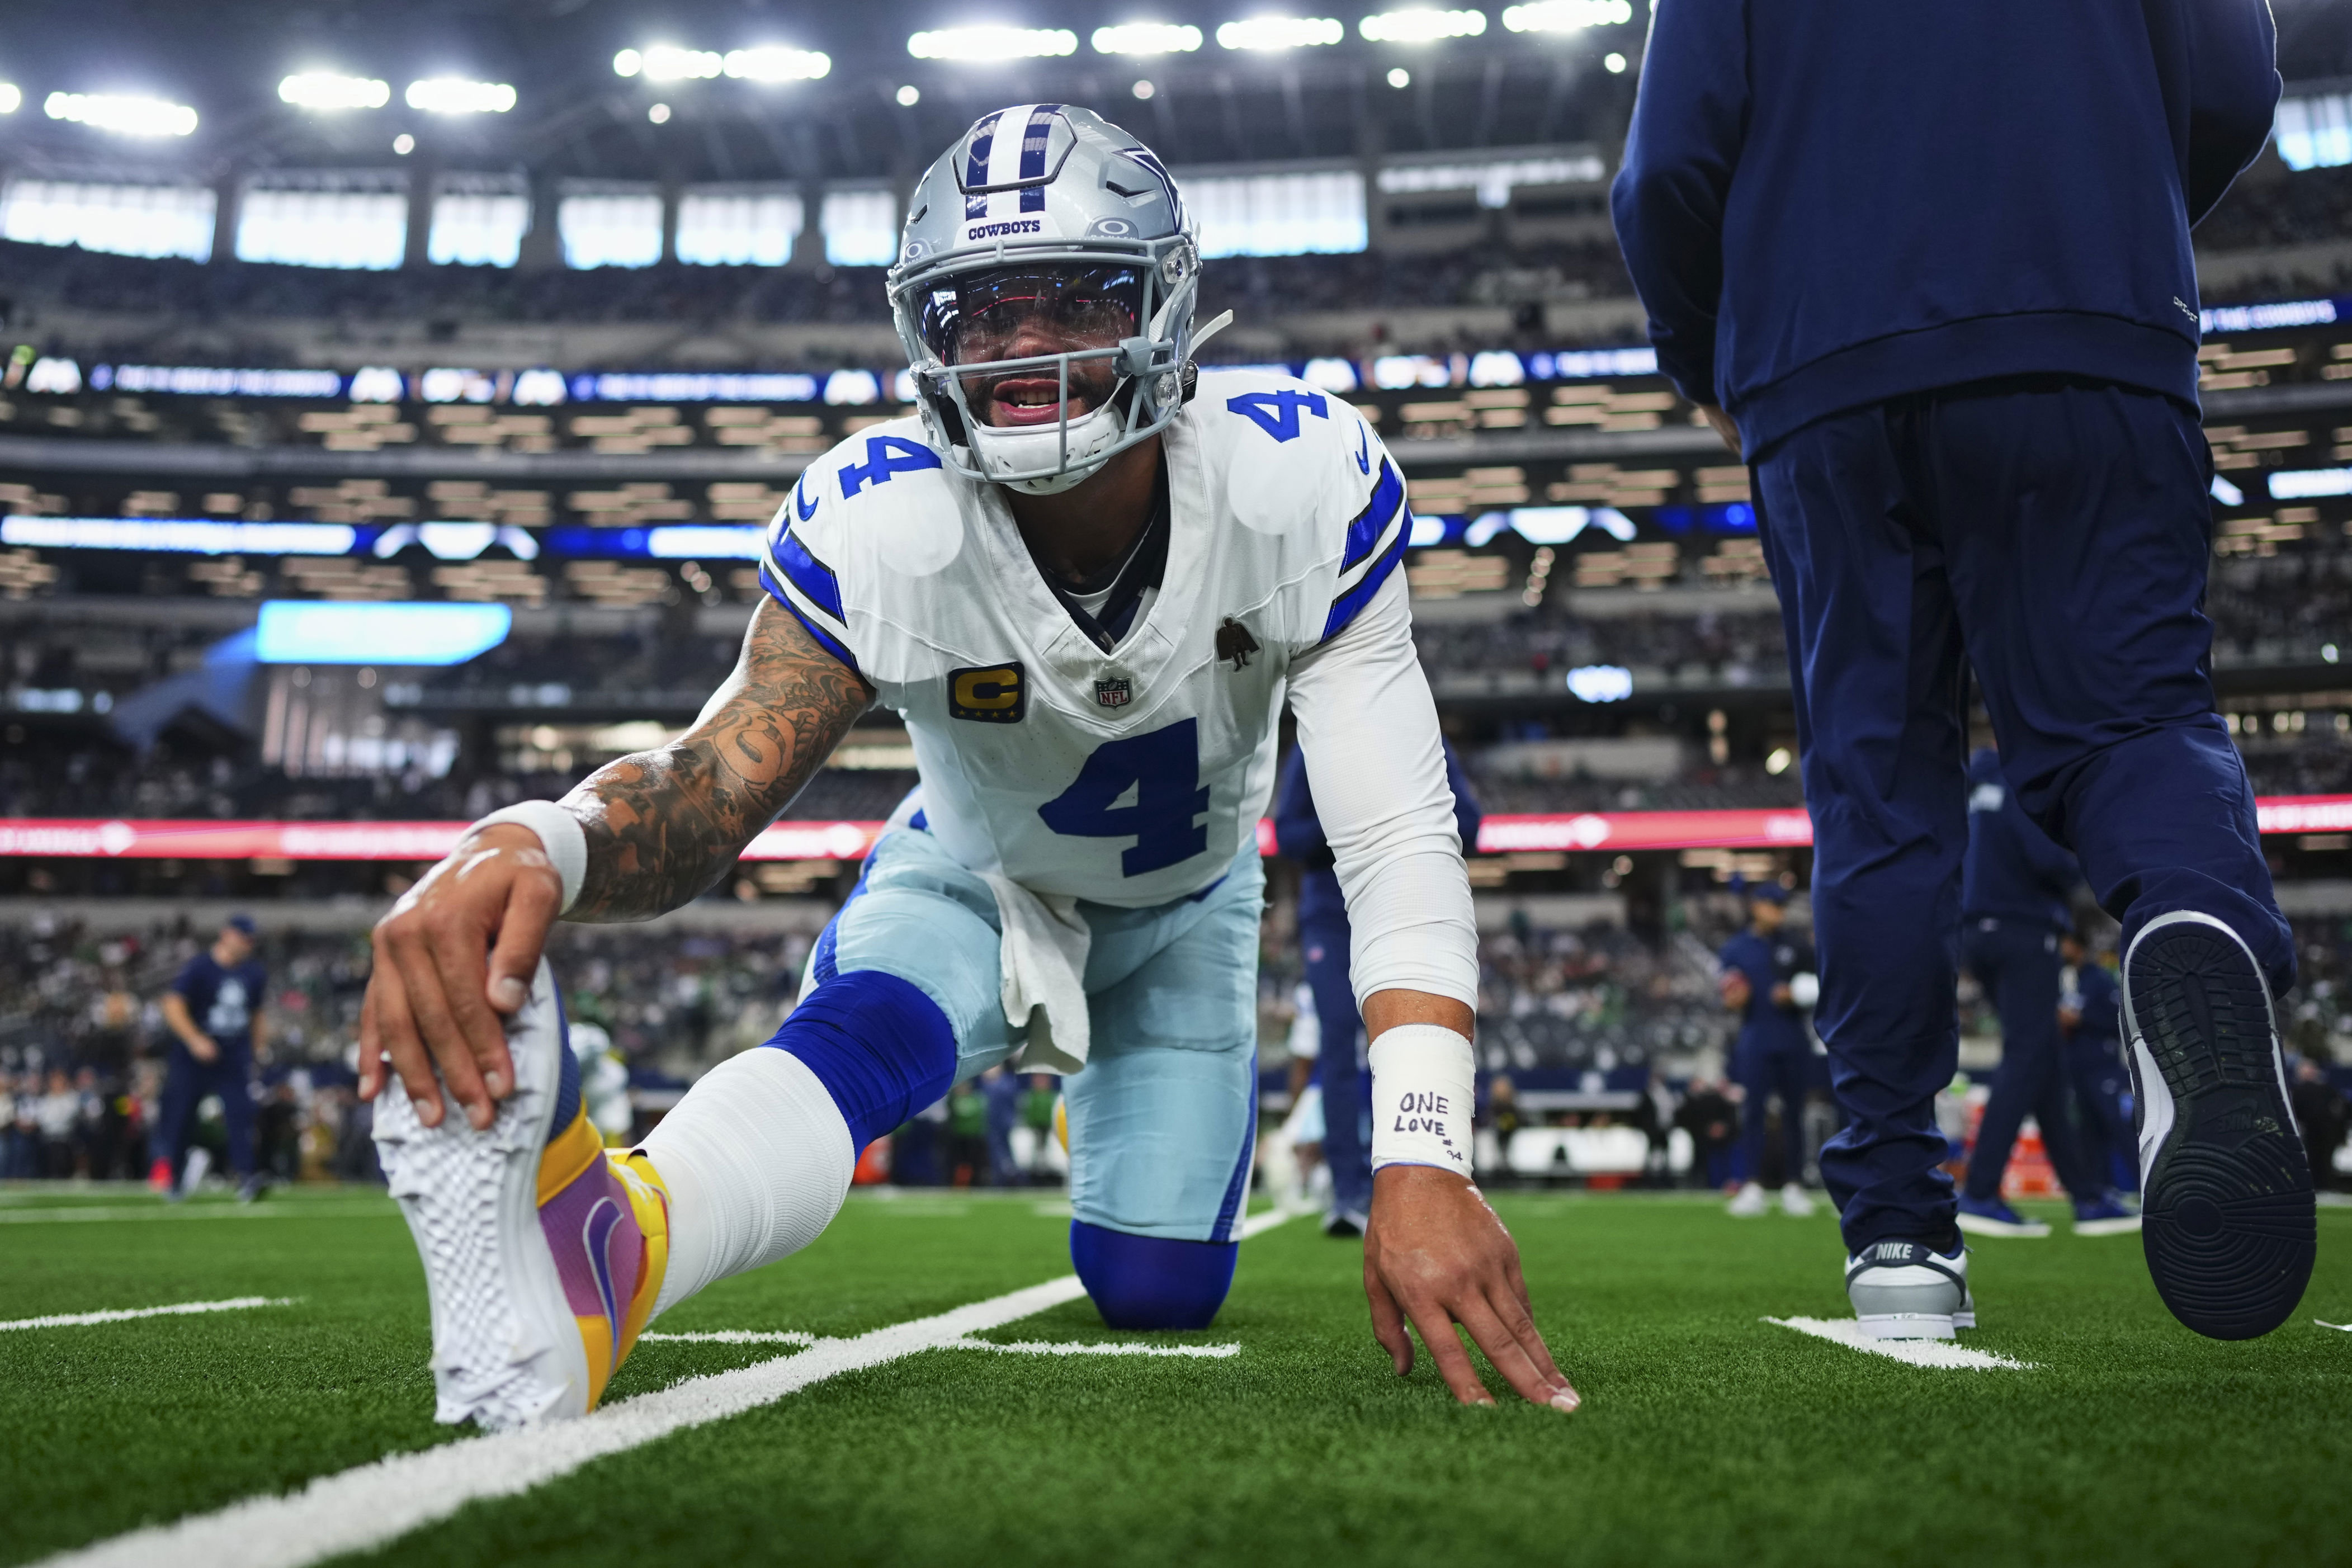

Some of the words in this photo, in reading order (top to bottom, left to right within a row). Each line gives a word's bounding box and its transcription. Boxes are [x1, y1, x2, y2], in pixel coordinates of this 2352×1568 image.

[969, 220, 1040, 240] COWBOYS
[1226, 389, 1329, 443] 4
[838, 435, 943, 500] 4
[955, 668, 1018, 710] C
[1100, 691, 1128, 705] NFL
[1037, 716, 1211, 879] 4
[1400, 1092, 1449, 1114] ONE
[1394, 1115, 1446, 1136] LOVE
[1876, 1243, 1914, 1260] NIKE
